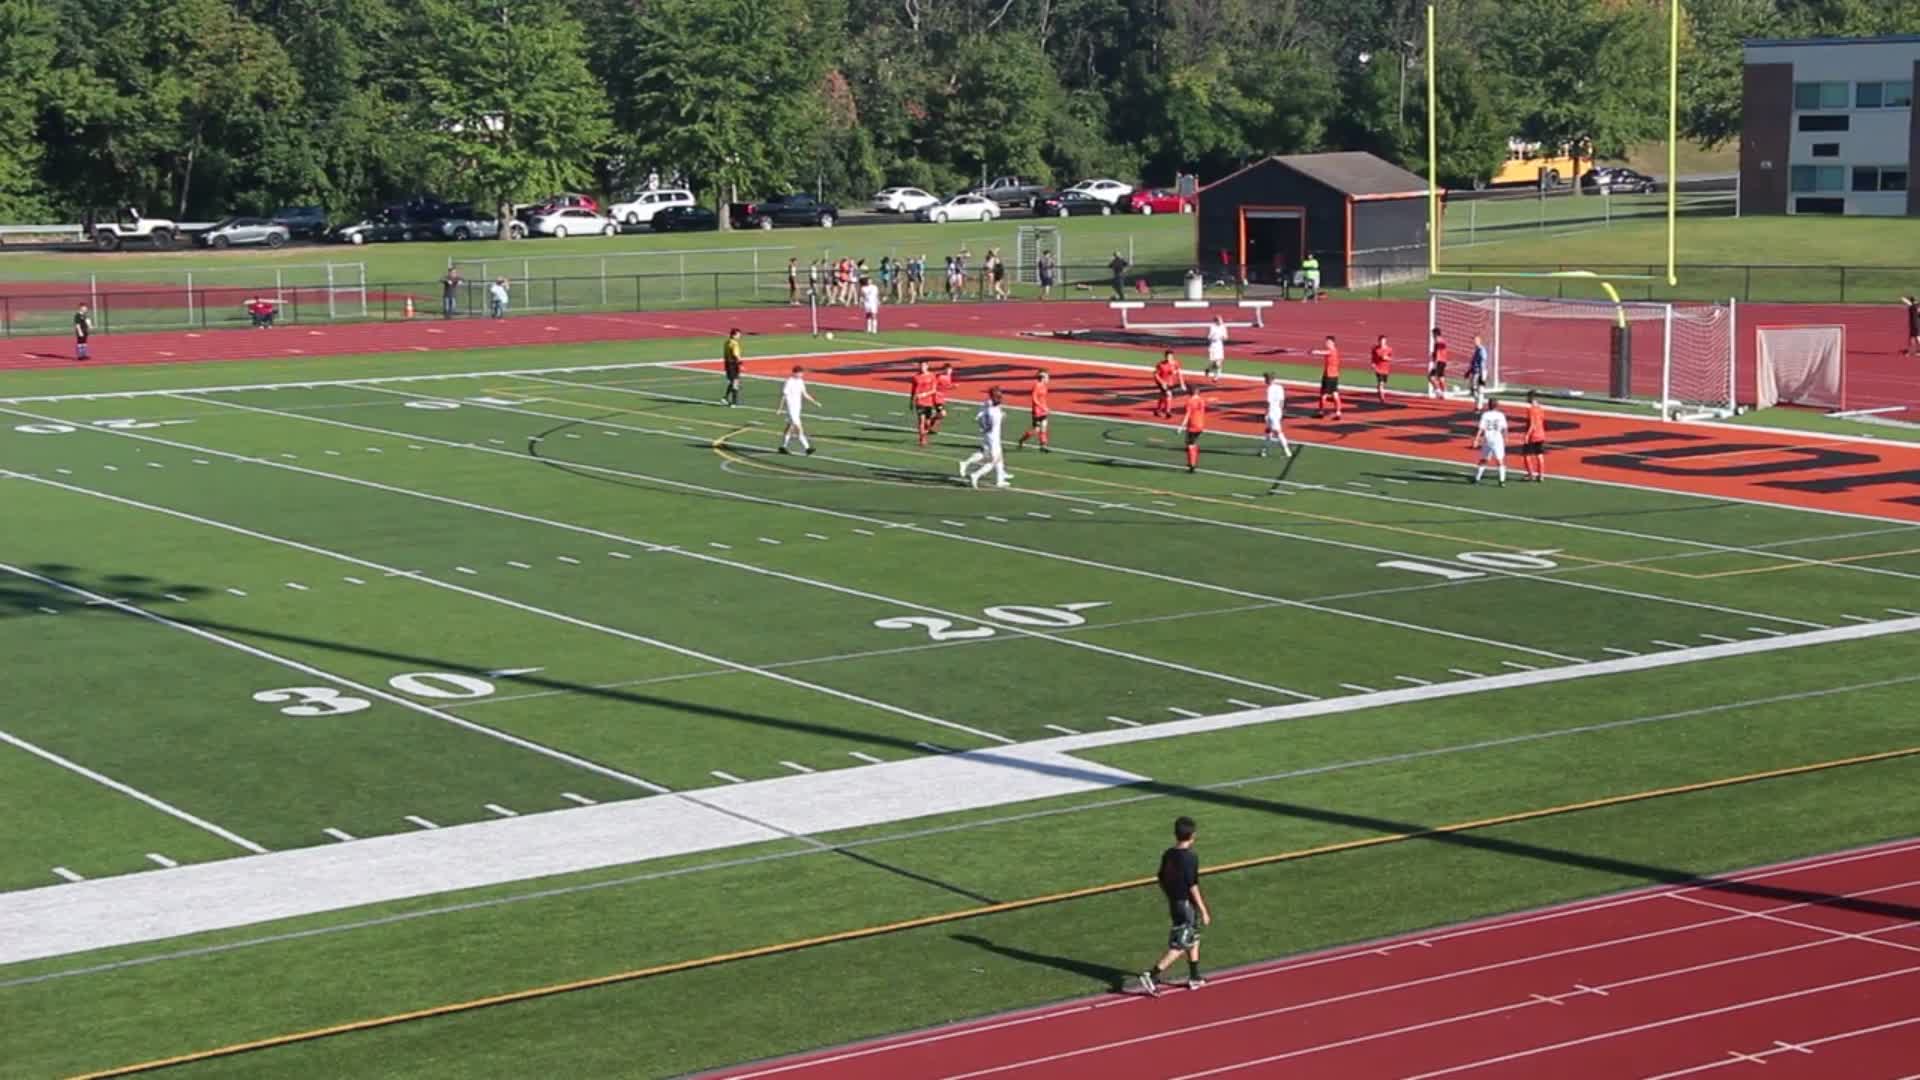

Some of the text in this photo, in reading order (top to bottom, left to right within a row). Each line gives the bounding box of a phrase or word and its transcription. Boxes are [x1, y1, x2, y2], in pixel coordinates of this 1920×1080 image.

[1375, 551, 1558, 580] 10
[873, 605, 1086, 640] 20
[252, 671, 496, 717] 30
